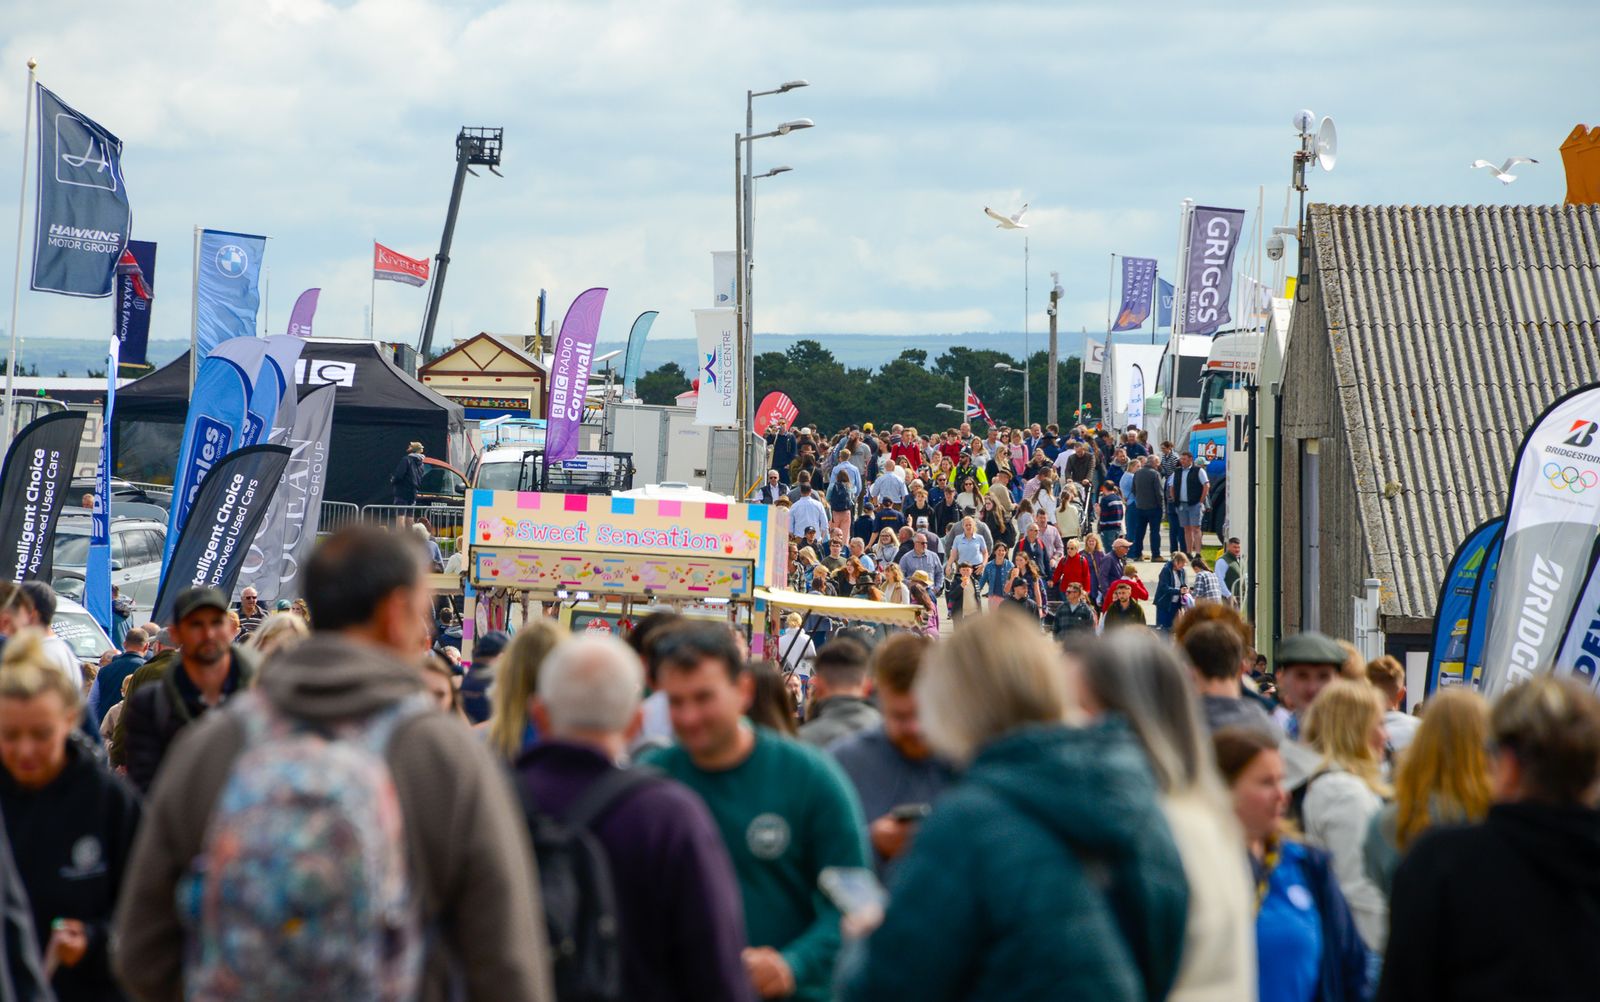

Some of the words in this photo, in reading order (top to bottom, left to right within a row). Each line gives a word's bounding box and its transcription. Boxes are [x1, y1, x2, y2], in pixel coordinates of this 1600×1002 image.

[48, 237, 81, 250] MOTOR
[83, 242, 119, 254] GROUP
[49, 223, 121, 243] HAWKINS
[1197, 216, 1230, 323] GRIGGS
[123, 301, 132, 309] &
[120, 311, 131, 342] FAVOR
[558, 337, 574, 375] RADIO
[722, 330, 732, 368] CENTRE
[552, 374, 569, 419] BBC
[567, 342, 592, 422] Cornwall
[723, 370, 732, 407] EVENTS
[46, 450, 59, 479] Cars
[309, 441, 325, 496] GROUP
[1545, 445, 1600, 465] BRIDGESTON
[41, 481, 55, 512] Used
[12, 504, 37, 584] Intelligent
[26, 448, 45, 502] Choice
[190, 524, 225, 590] telligent
[216, 473, 245, 524] Choice
[208, 537, 235, 592] Approved
[229, 507, 247, 536] Used
[241, 478, 259, 507] Cars
[28, 514, 49, 574] Approved
[517, 521, 588, 543] Sweet
[597, 525, 720, 550] Sensation
